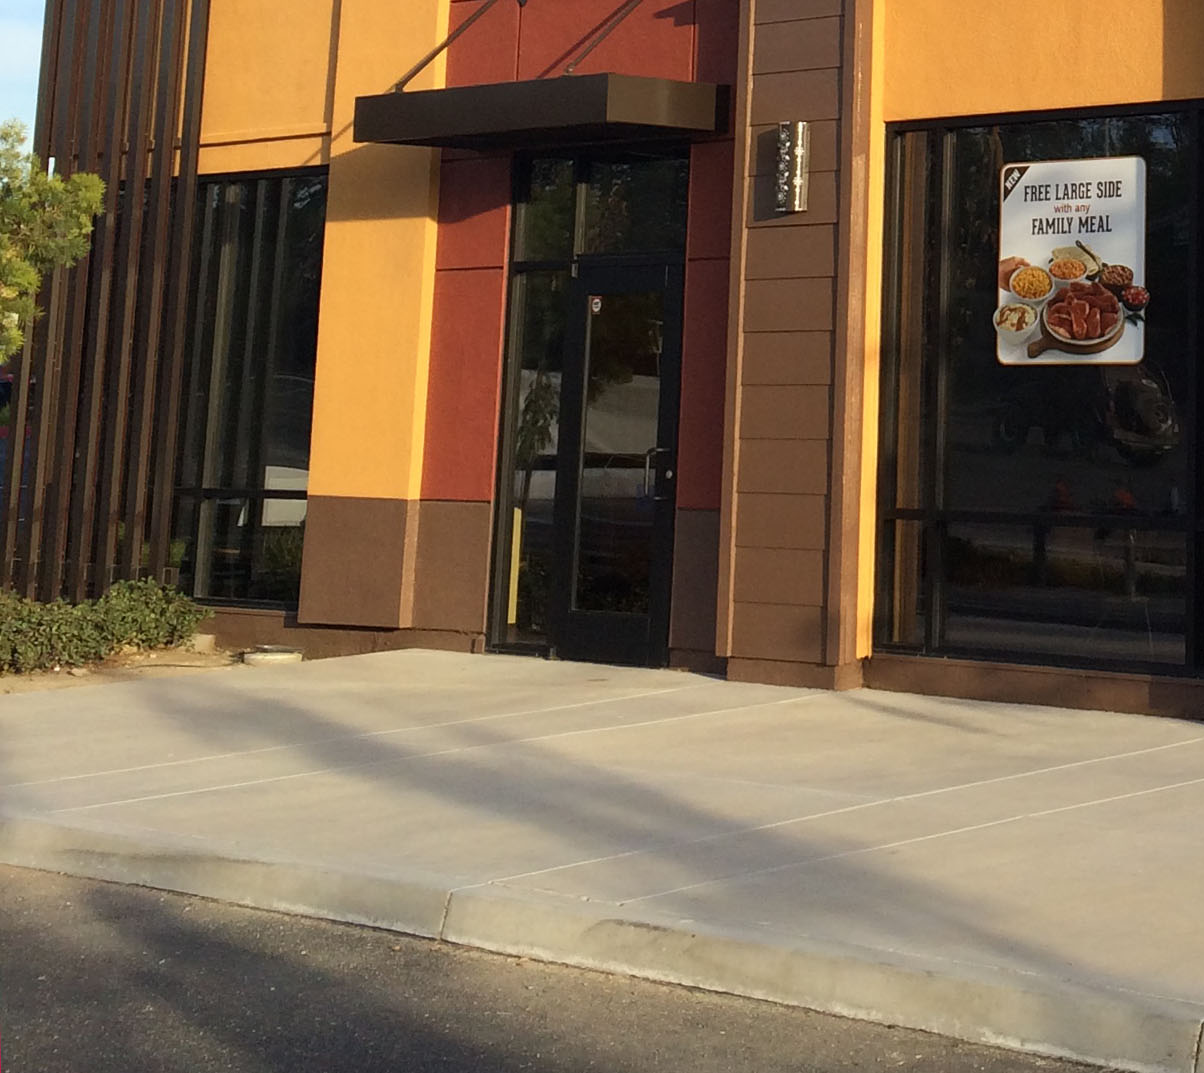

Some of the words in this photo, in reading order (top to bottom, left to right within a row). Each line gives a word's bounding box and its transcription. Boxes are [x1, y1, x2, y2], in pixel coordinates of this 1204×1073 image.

[1004, 168, 1021, 190] NEW
[1023, 184, 1051, 202] FREE
[1055, 182, 1092, 201] LARGE
[1096, 180, 1123, 199] SIDE
[1053, 203, 1073, 214] with
[1074, 203, 1091, 215] any
[1031, 216, 1074, 235] FAMILY
[1078, 215, 1113, 234] MEAL
